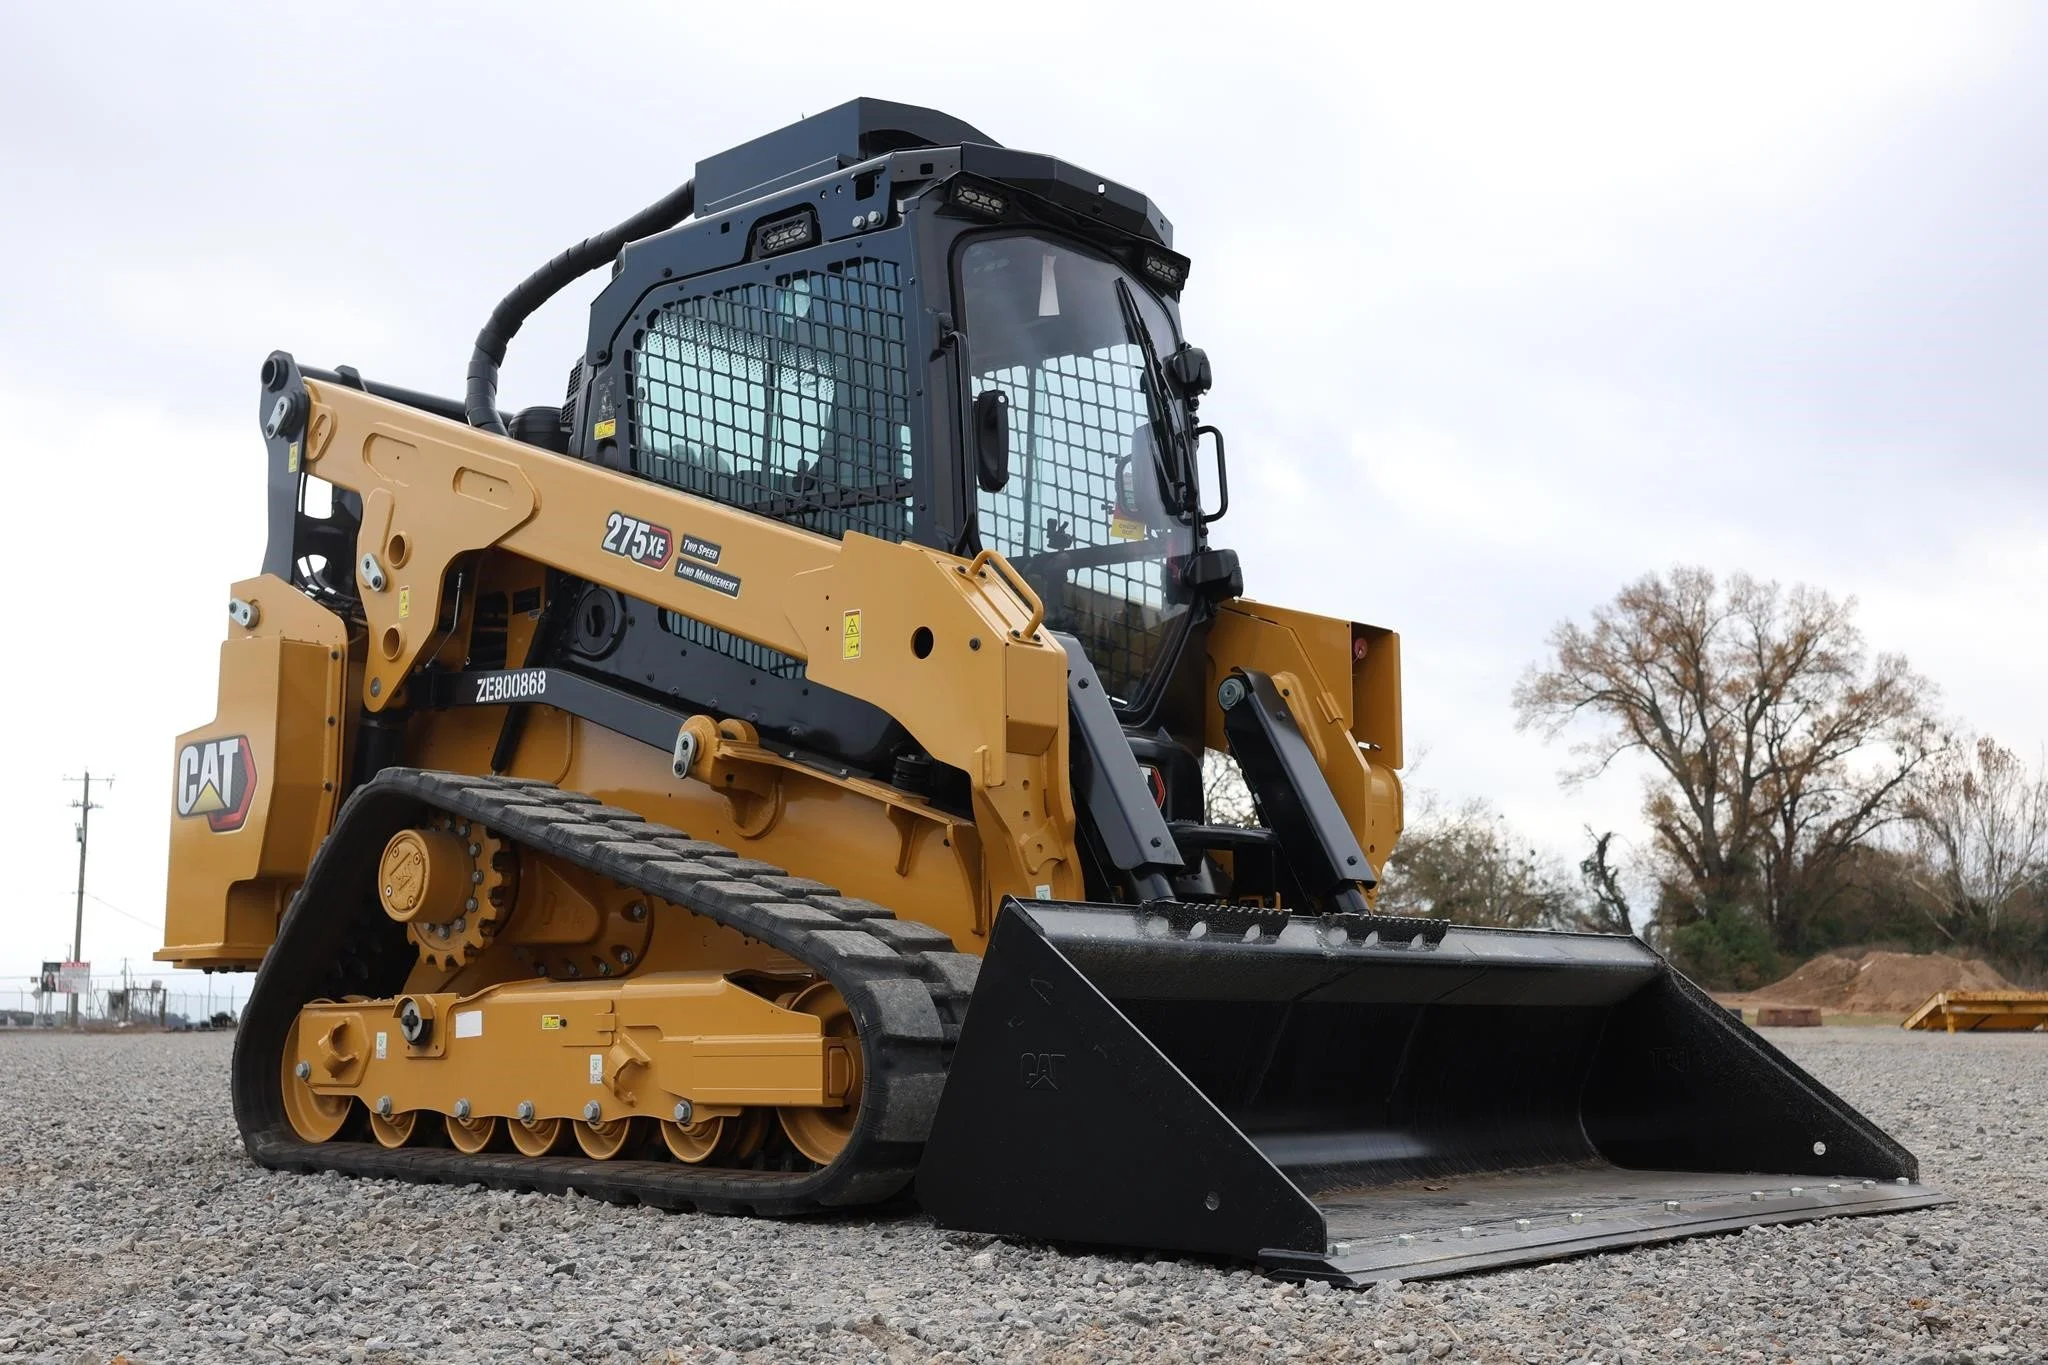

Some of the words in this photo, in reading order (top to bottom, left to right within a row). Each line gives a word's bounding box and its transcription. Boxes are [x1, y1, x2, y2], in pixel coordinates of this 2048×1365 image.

[602, 513, 666, 560] 275XE
[683, 540, 698, 553] TWO
[697, 545, 718, 560] SPEED
[678, 563, 694, 577] LAND
[694, 569, 738, 592] MANAGEMENT
[475, 670, 546, 703] ZE800868
[178, 738, 239, 815] CAT
[1021, 1053, 1066, 1089] CAT
